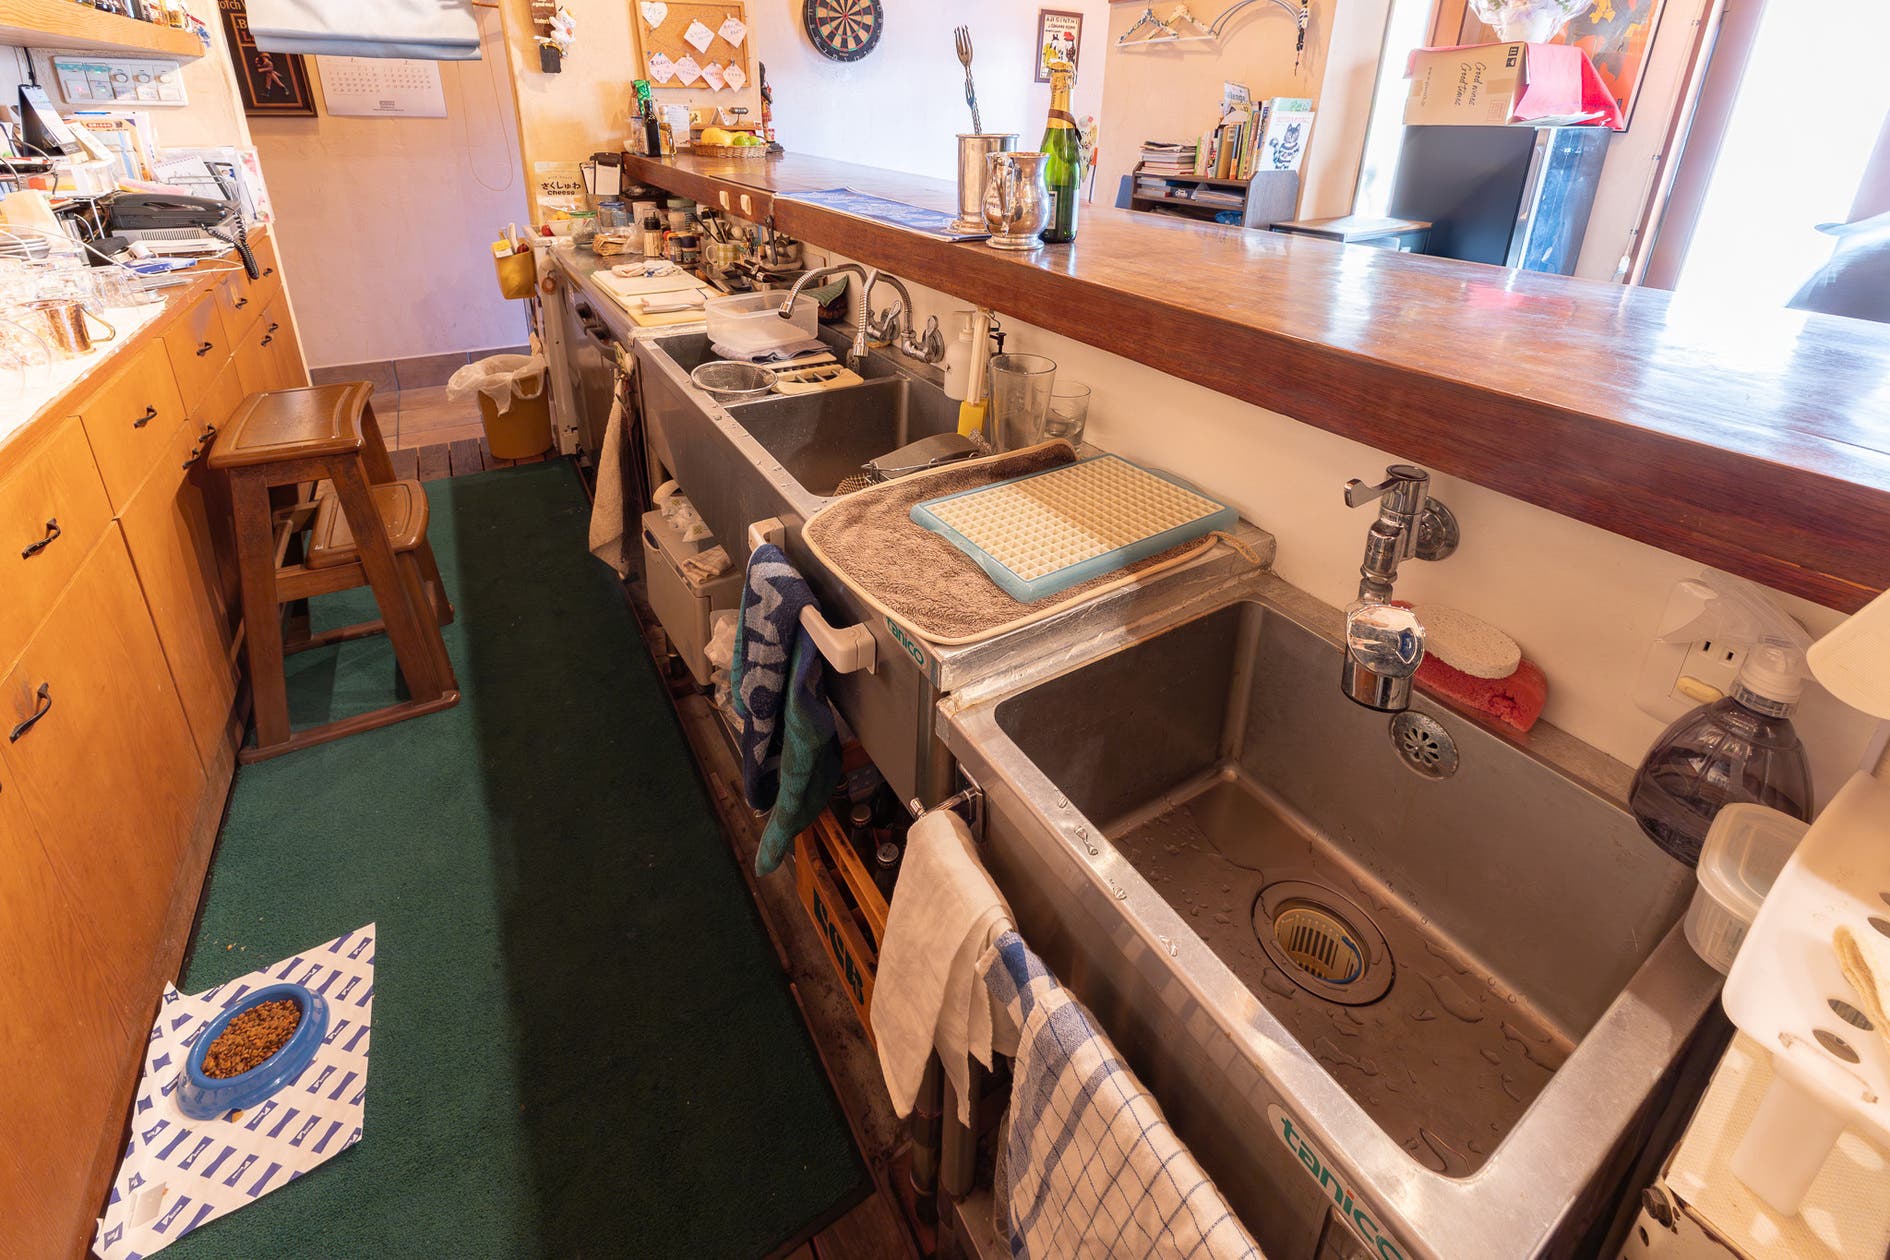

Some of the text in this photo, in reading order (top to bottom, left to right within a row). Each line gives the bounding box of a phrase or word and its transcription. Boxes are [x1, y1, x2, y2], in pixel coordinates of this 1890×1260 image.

[541, 181, 581, 190] さくしゅわ
